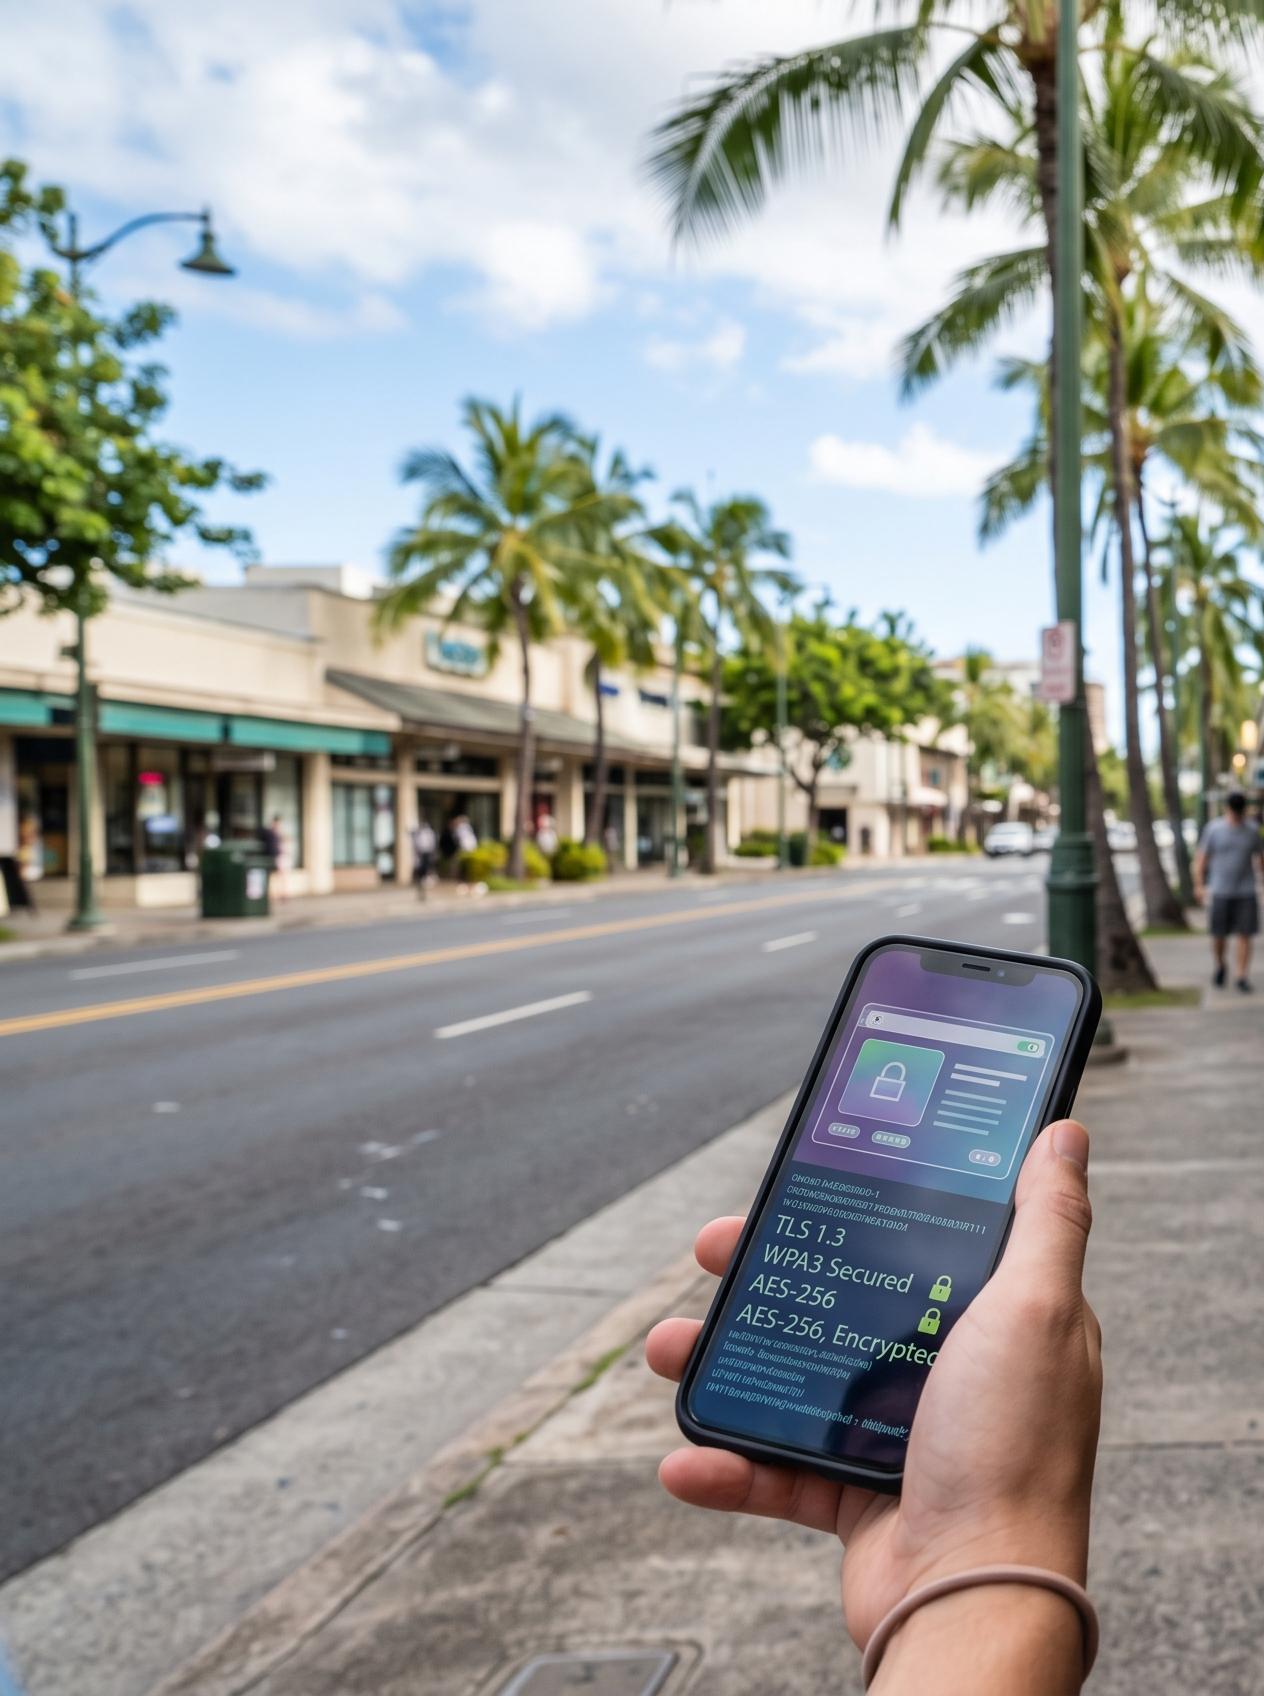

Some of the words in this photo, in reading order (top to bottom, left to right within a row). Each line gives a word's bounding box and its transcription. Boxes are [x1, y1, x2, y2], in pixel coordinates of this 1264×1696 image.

[774, 1214, 812, 1240] TLS
[815, 1223, 846, 1246] 1.3
[763, 1243, 822, 1273] WPA3
[826, 1257, 914, 1294] Secured
[748, 1273, 837, 1309] AES-256
[736, 1303, 827, 1343] AES-256,
